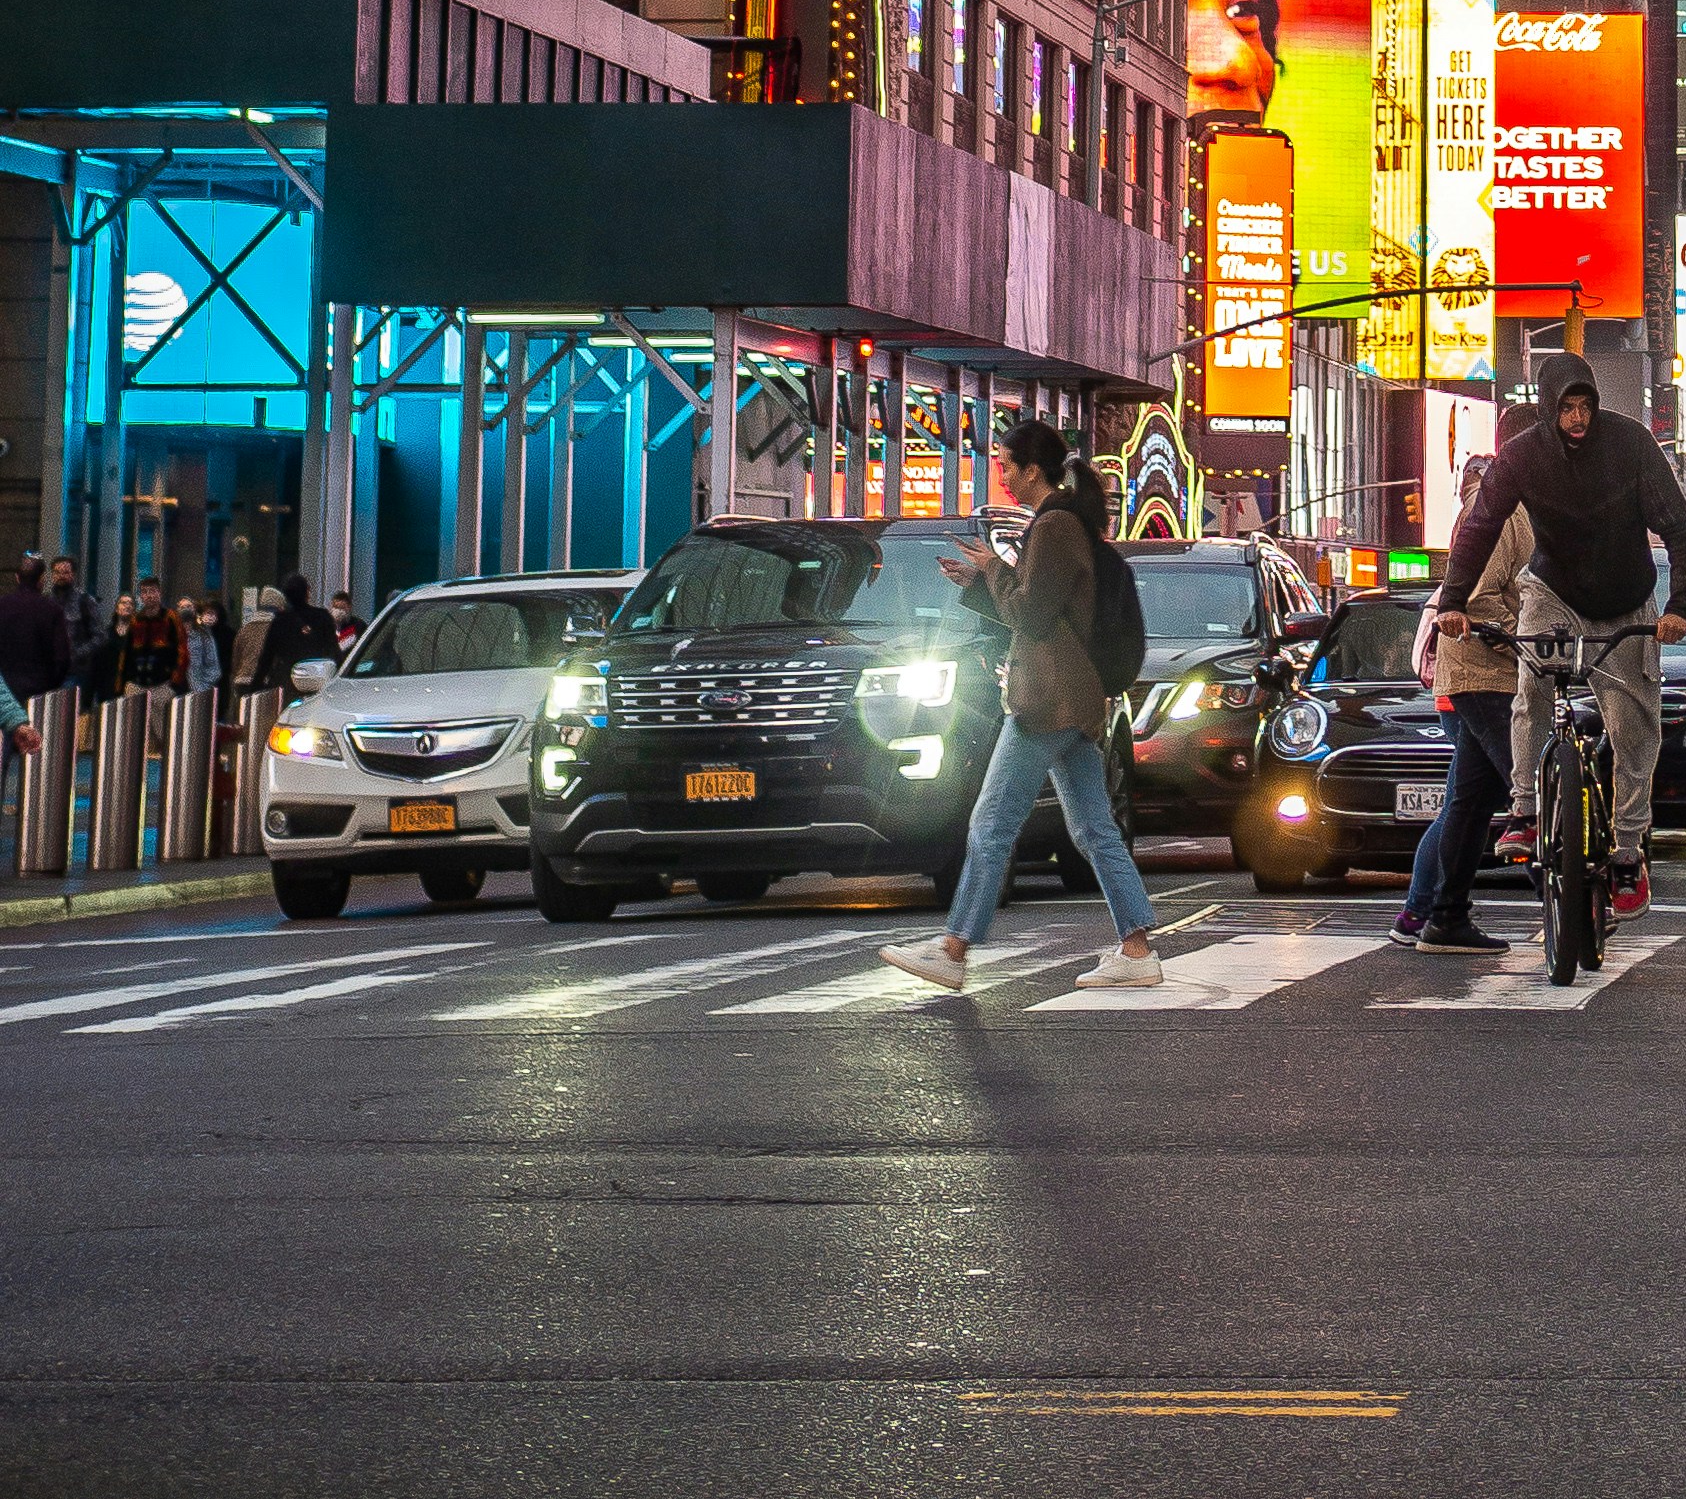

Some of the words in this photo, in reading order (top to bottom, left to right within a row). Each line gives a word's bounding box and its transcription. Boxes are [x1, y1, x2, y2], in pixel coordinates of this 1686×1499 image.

[1450, 50, 1472, 73] GET
[1436, 77, 1487, 100] TICKETS
[1437, 105, 1486, 141] HERE
[1493, 126, 1623, 150] OGETHER
[1438, 145, 1485, 172] TODAY
[1493, 156, 1604, 179] TASTES
[1310, 250, 1348, 276] US
[1214, 299, 1283, 337] ONE
[1214, 337, 1283, 369] LOVE
[651, 660, 828, 673] EXPLORER
